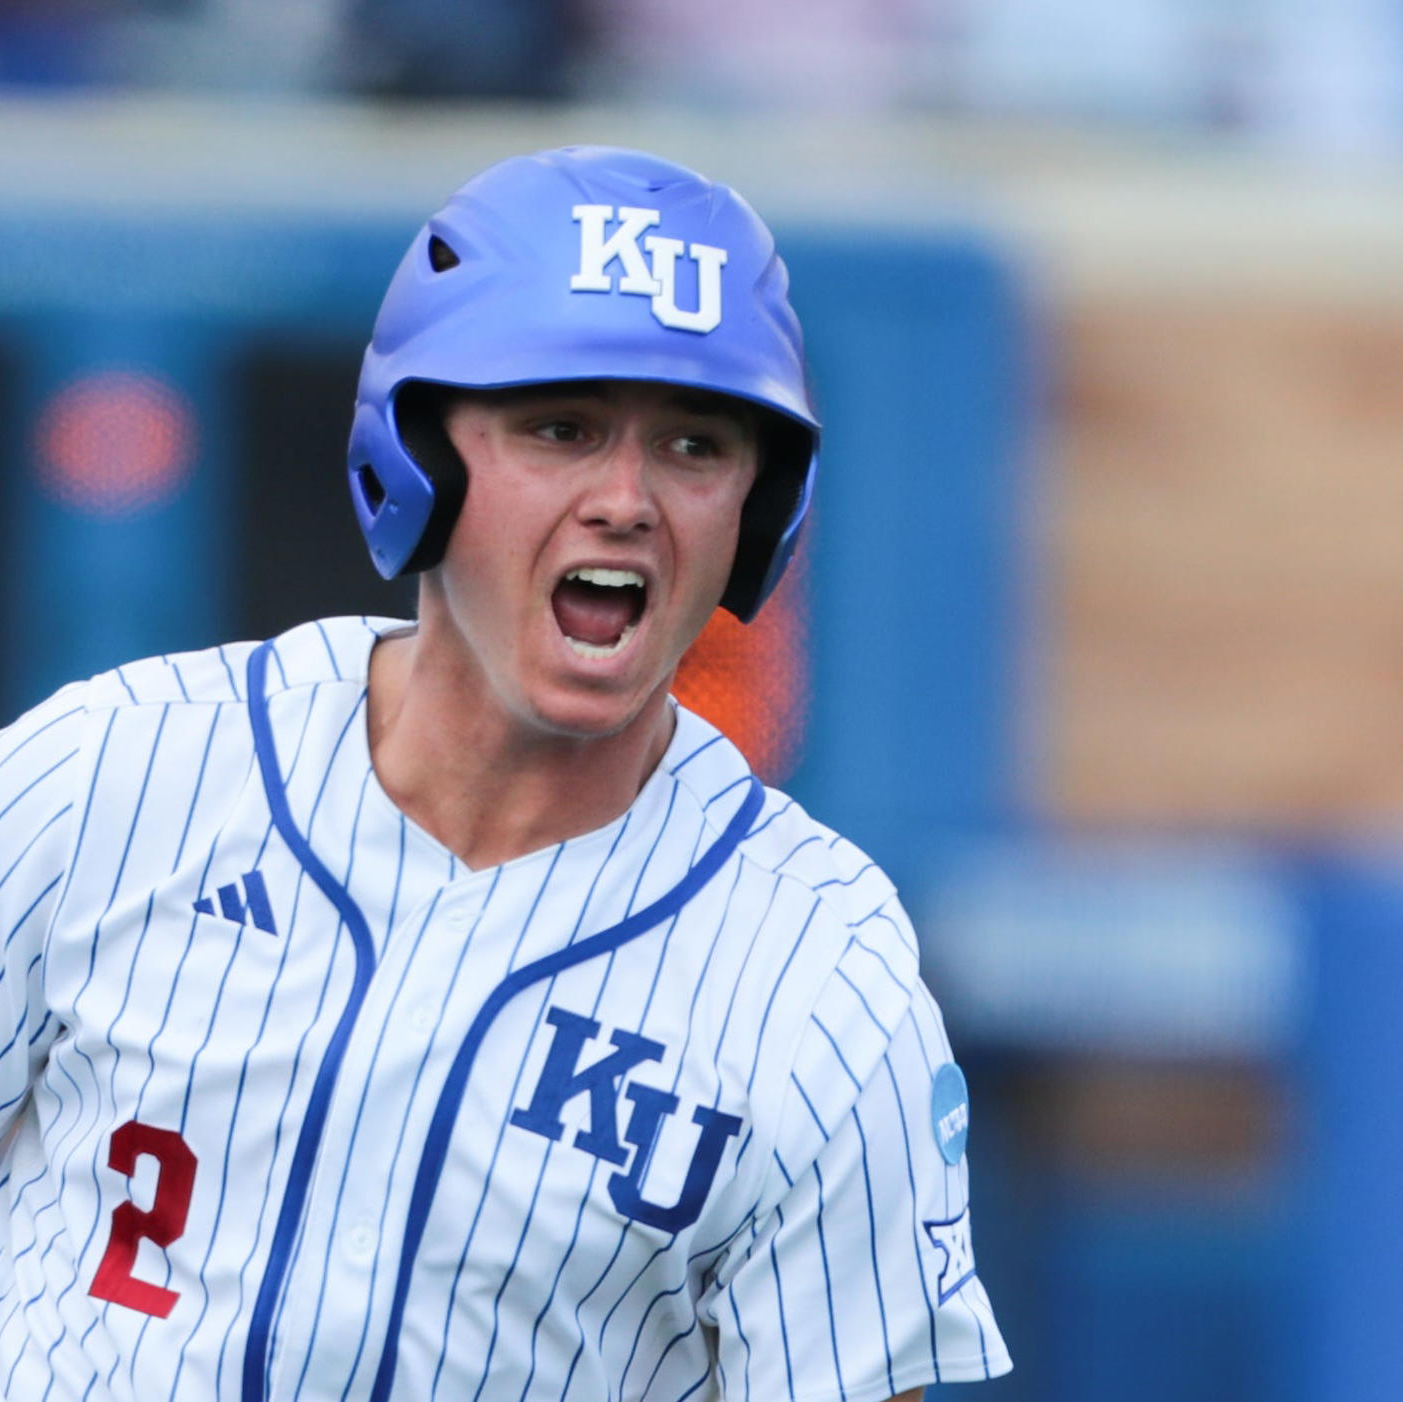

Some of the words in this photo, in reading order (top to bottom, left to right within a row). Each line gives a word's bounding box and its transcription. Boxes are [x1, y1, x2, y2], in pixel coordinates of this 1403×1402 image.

[570, 205, 728, 334] KU
[87, 1119, 198, 1320] 2
[509, 1005, 743, 1234] KU
